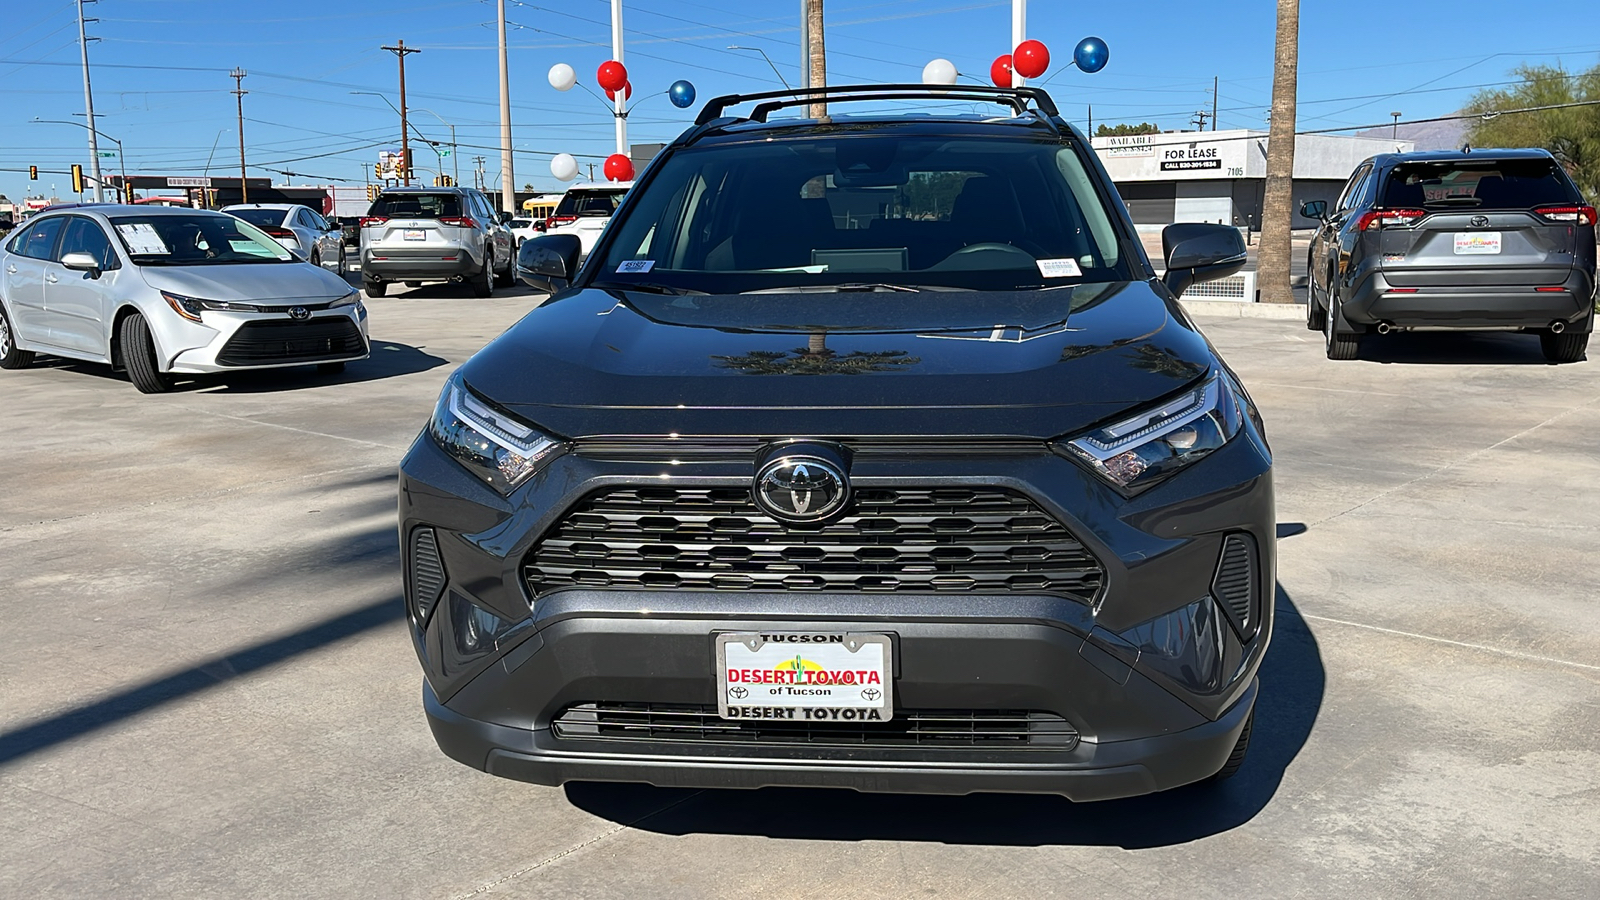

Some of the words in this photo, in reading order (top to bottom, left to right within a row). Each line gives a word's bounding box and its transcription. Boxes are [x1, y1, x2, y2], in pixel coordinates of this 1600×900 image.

[1109, 136, 1153, 145] AVAILABLE
[1165, 150, 1185, 159] FOR
[1188, 148, 1217, 158] LEASE
[1227, 167, 1244, 176] 7105
[760, 634, 843, 643] TUCSON
[728, 669, 797, 684] DESERT
[804, 670, 881, 685] TOYOTA
[769, 686, 782, 696] of
[785, 686, 832, 696] Tucson
[727, 707, 796, 719] DESERT
[803, 707, 882, 720] TOYOTA
